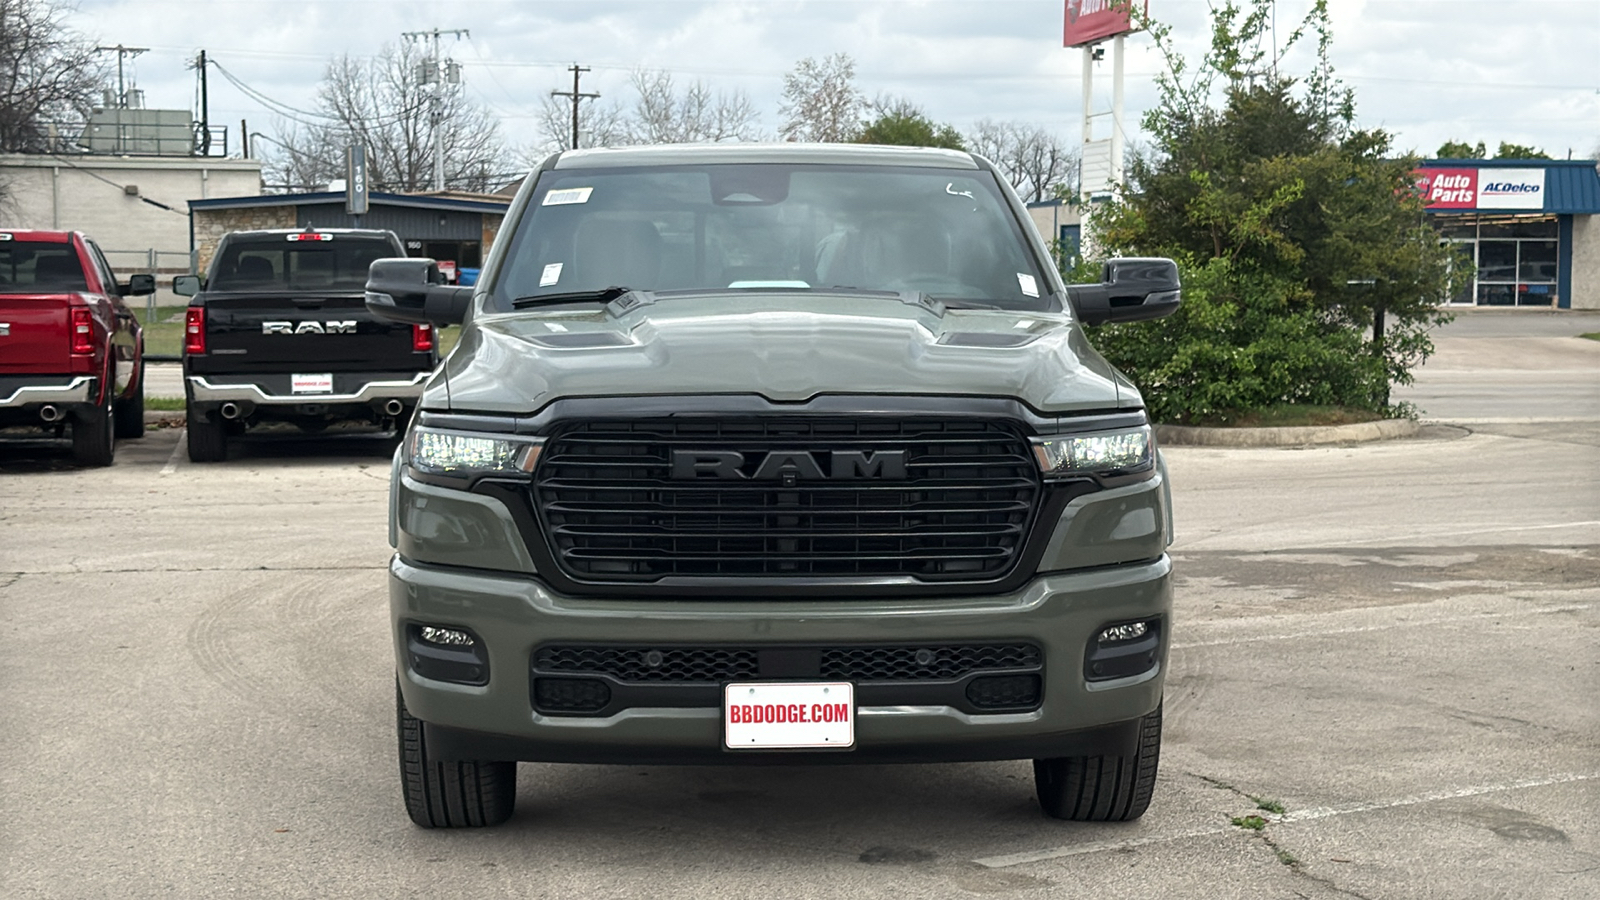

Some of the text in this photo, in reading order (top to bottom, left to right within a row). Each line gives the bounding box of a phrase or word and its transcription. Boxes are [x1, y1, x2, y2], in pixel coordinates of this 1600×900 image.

[355, 165, 364, 193] 160
[1432, 173, 1471, 188] Auto
[1483, 182, 1540, 193] ACDelco
[1431, 188, 1474, 203] Parts
[262, 321, 358, 335] RAM
[672, 449, 908, 480] RAM
[730, 703, 849, 724] BBDODGE.COM
